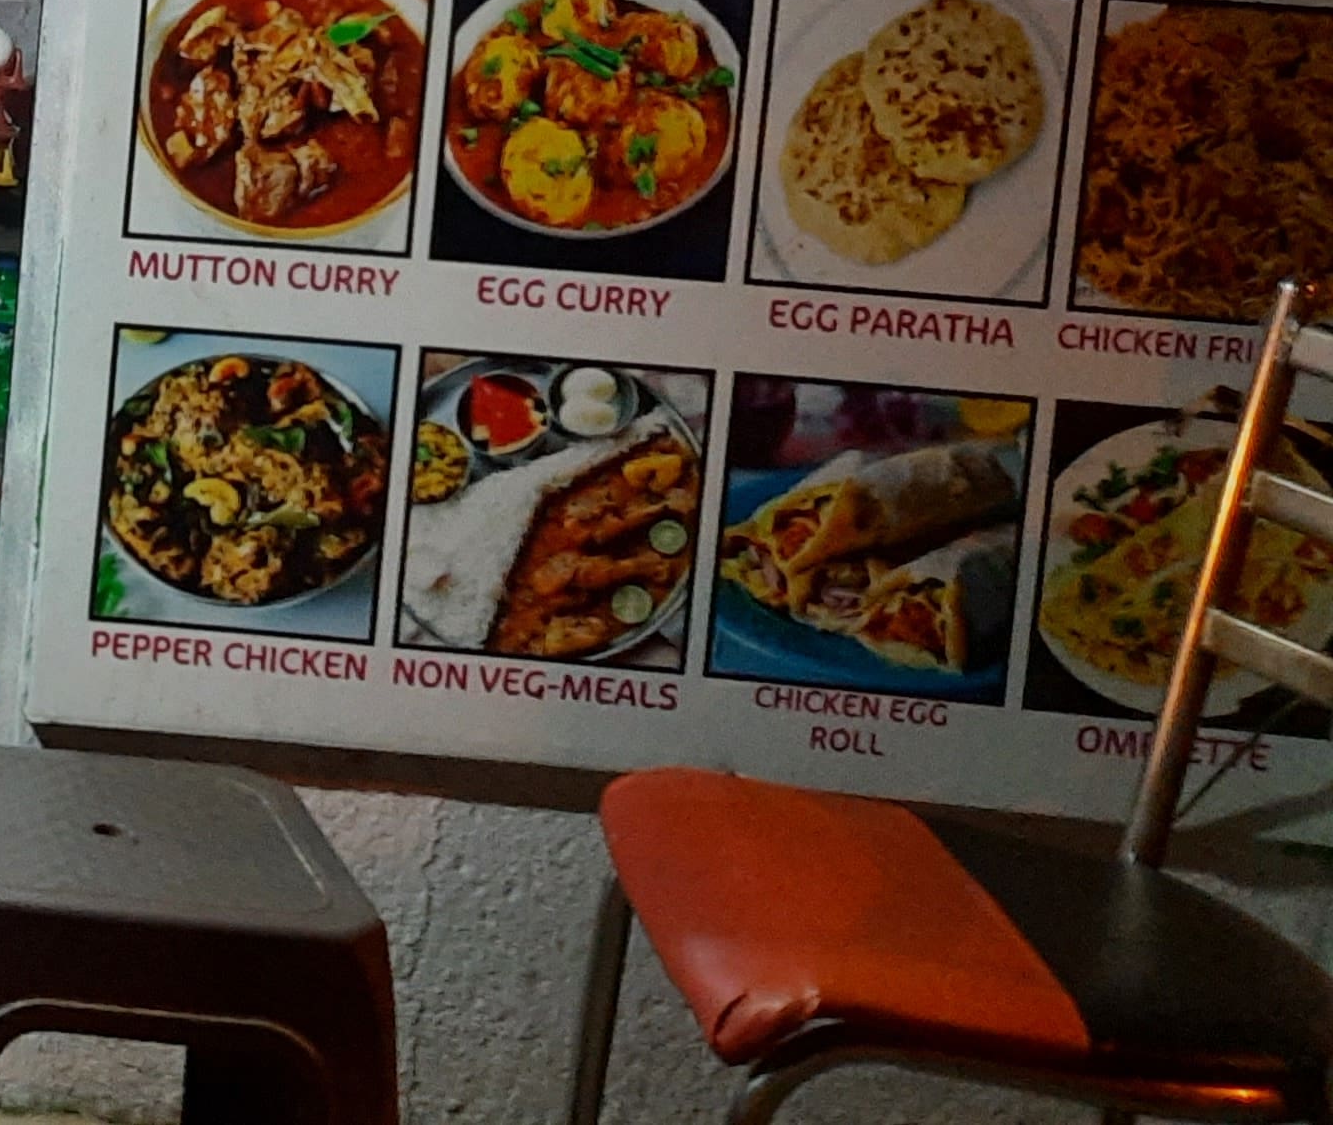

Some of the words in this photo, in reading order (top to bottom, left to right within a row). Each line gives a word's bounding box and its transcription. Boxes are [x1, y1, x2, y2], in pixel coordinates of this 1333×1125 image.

[127, 251, 277, 288] MUTTON
[286, 261, 399, 299] CURRY
[476, 276, 549, 310] EGG
[559, 281, 672, 321] CURRY
[767, 300, 841, 335] EGG
[850, 305, 1016, 350] PARATHA
[1057, 322, 1196, 360] CHICKEN
[1206, 335, 1254, 365] FRI
[90, 629, 213, 670] PEPPER
[223, 639, 369, 683] CHICKEN
[392, 653, 471, 690] NON
[480, 660, 679, 714] VEG-MEALS
[755, 684, 880, 721] CHICKEN
[888, 699, 949, 727] EGG
[810, 726, 885, 757] ROLL
[1077, 725, 1273, 771] OMETTE
